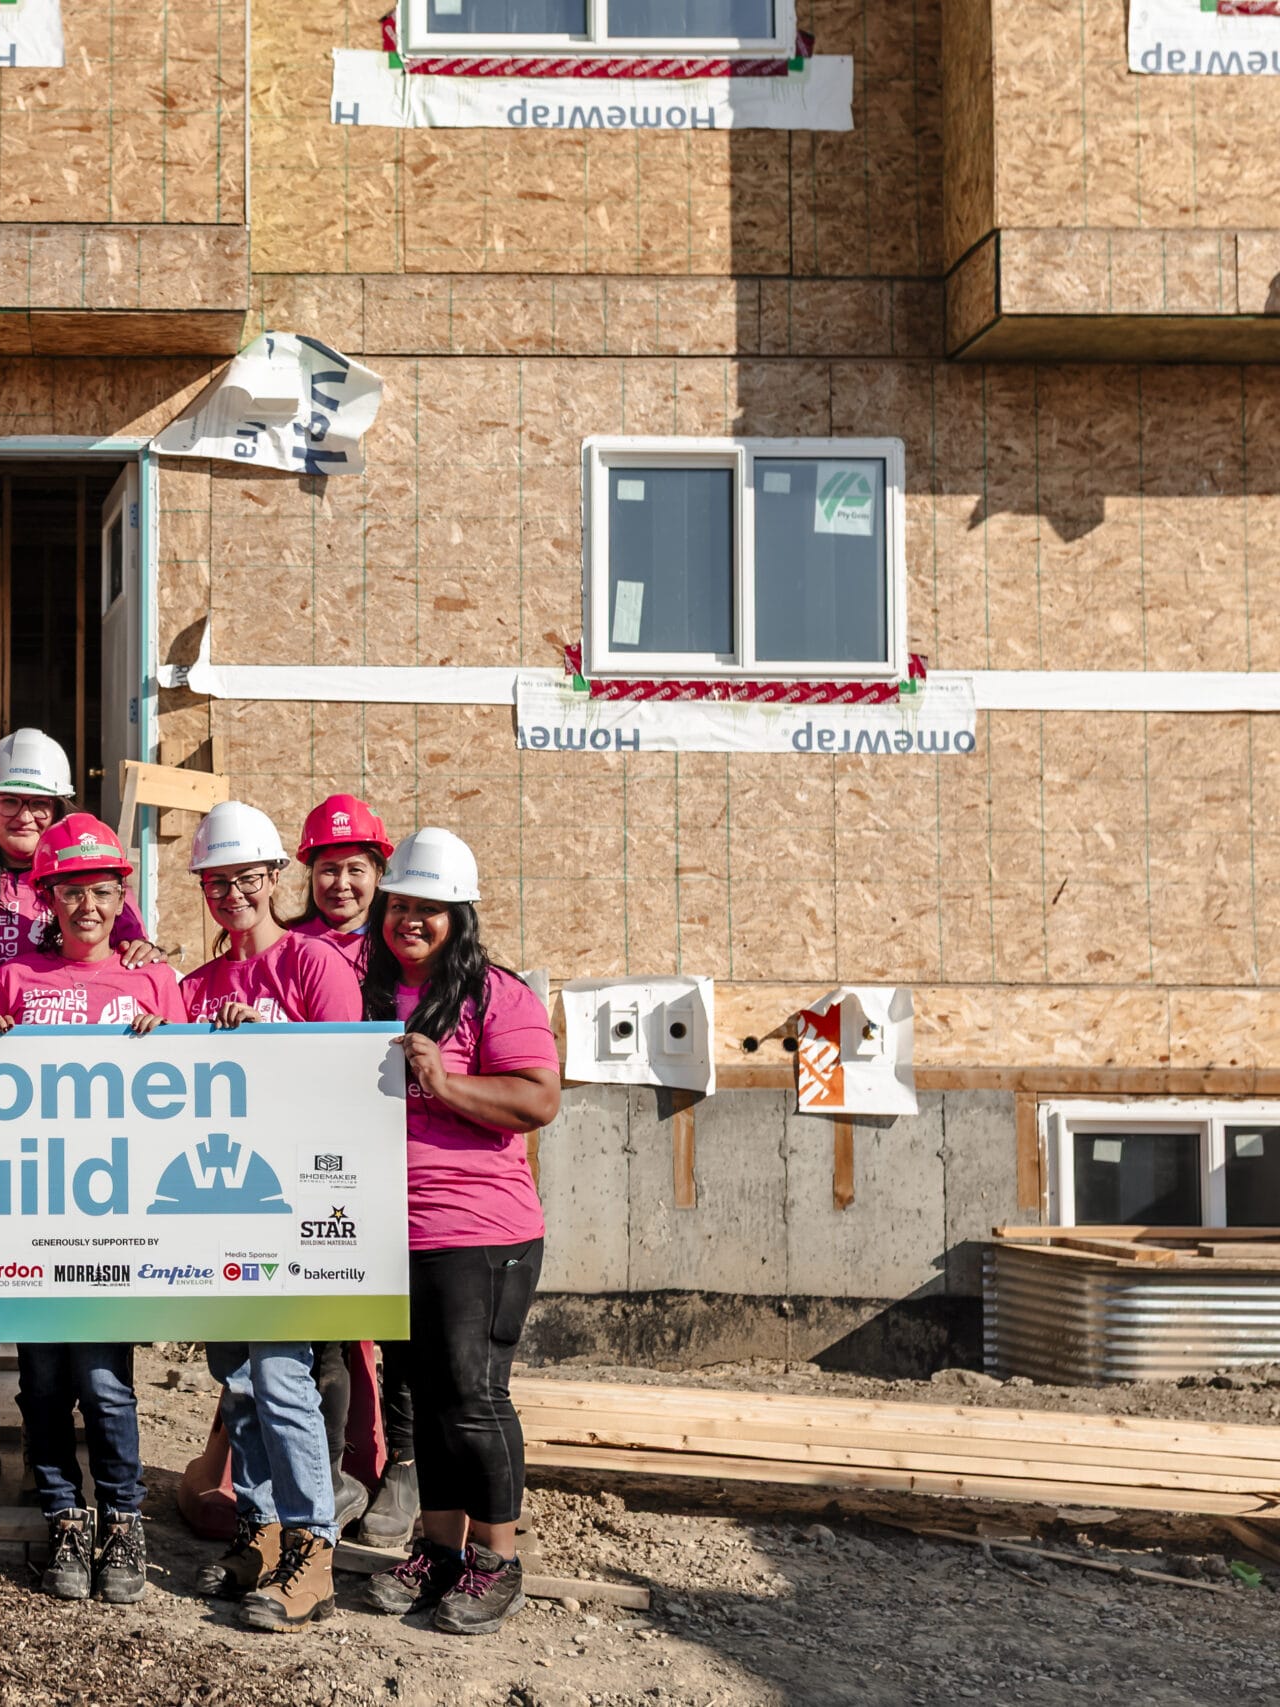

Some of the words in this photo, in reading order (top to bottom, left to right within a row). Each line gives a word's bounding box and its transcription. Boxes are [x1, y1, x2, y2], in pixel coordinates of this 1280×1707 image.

[516, 726, 641, 753] Home
[9, 767, 42, 776] GENESIS
[207, 840, 241, 851] GENESIS
[406, 869, 440, 881] GENESIS
[24, 996, 88, 1011] WOMEN
[22, 1009, 88, 1025] BUILD
[299, 1173, 357, 1181] SHOEMAKER
[301, 1221, 357, 1239] STAR
[31, 1239, 90, 1247] GENEROUSLY
[92, 1238, 146, 1246] SUPPORTED
[147, 1238, 159, 1246] BY
[248, 1251, 278, 1259] Sponsor
[136, 1263, 215, 1286] Empire
[222, 1262, 280, 1282] CTV
[304, 1267, 366, 1283] bakertilly
[11, 1280, 43, 1288] SERVICE
